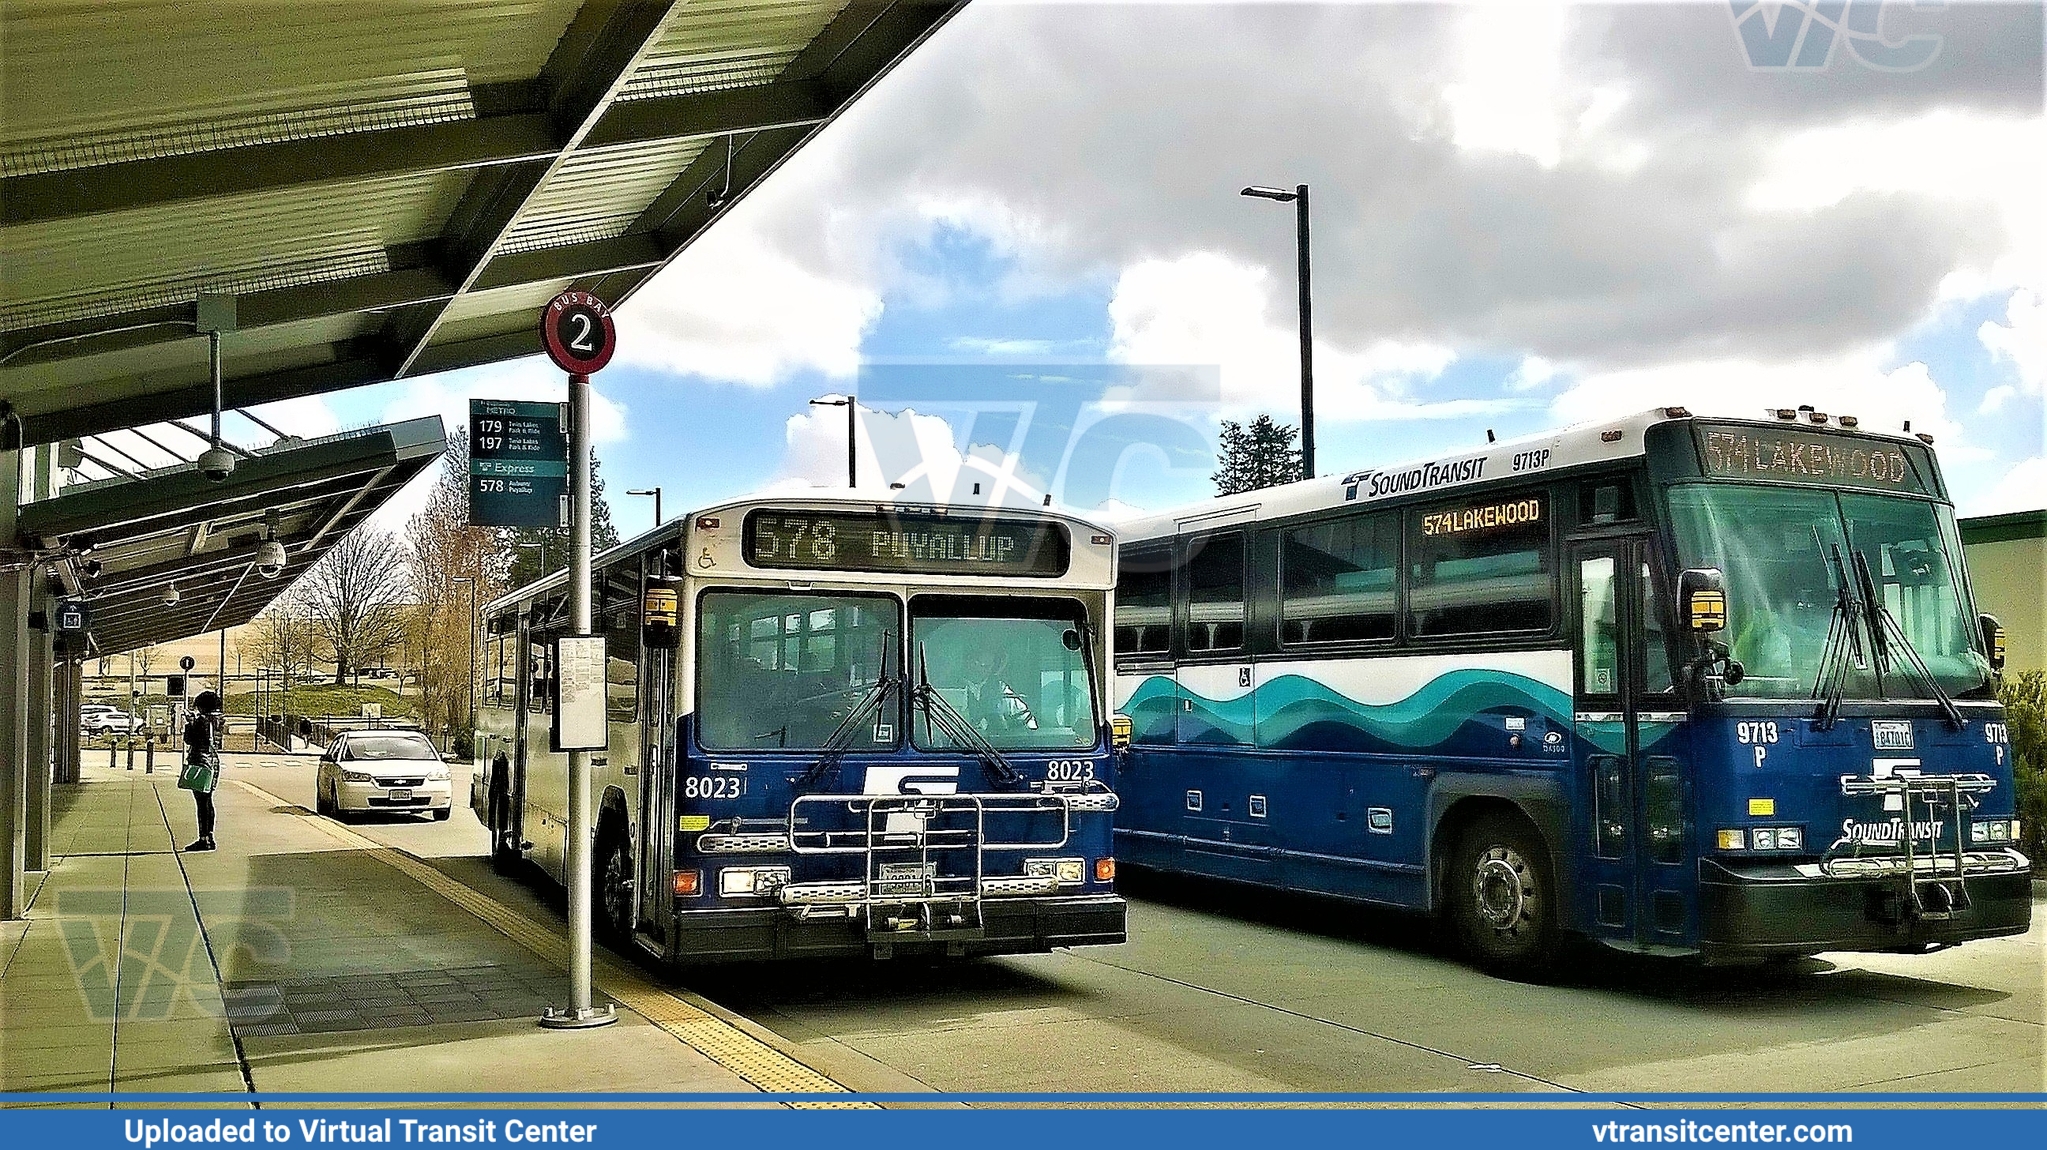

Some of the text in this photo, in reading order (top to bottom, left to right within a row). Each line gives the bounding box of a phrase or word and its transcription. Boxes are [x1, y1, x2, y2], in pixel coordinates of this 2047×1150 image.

[554, 293, 609, 318] BUS BAY
[571, 314, 592, 351] 2
[480, 420, 502, 433] 179
[480, 436, 502, 450] 197
[495, 463, 535, 475] Express
[1512, 449, 1550, 472] 9713P
[480, 479, 504, 493] 578
[756, 517, 1014, 562] 578 PUYALLUP
[1737, 721, 1778, 744] 9713
[1984, 723, 2008, 744] 9713
[1754, 746, 1767, 768] P
[1995, 745, 2004, 766] P
[1047, 760, 1094, 780] 8023
[685, 776, 740, 799] 8023
